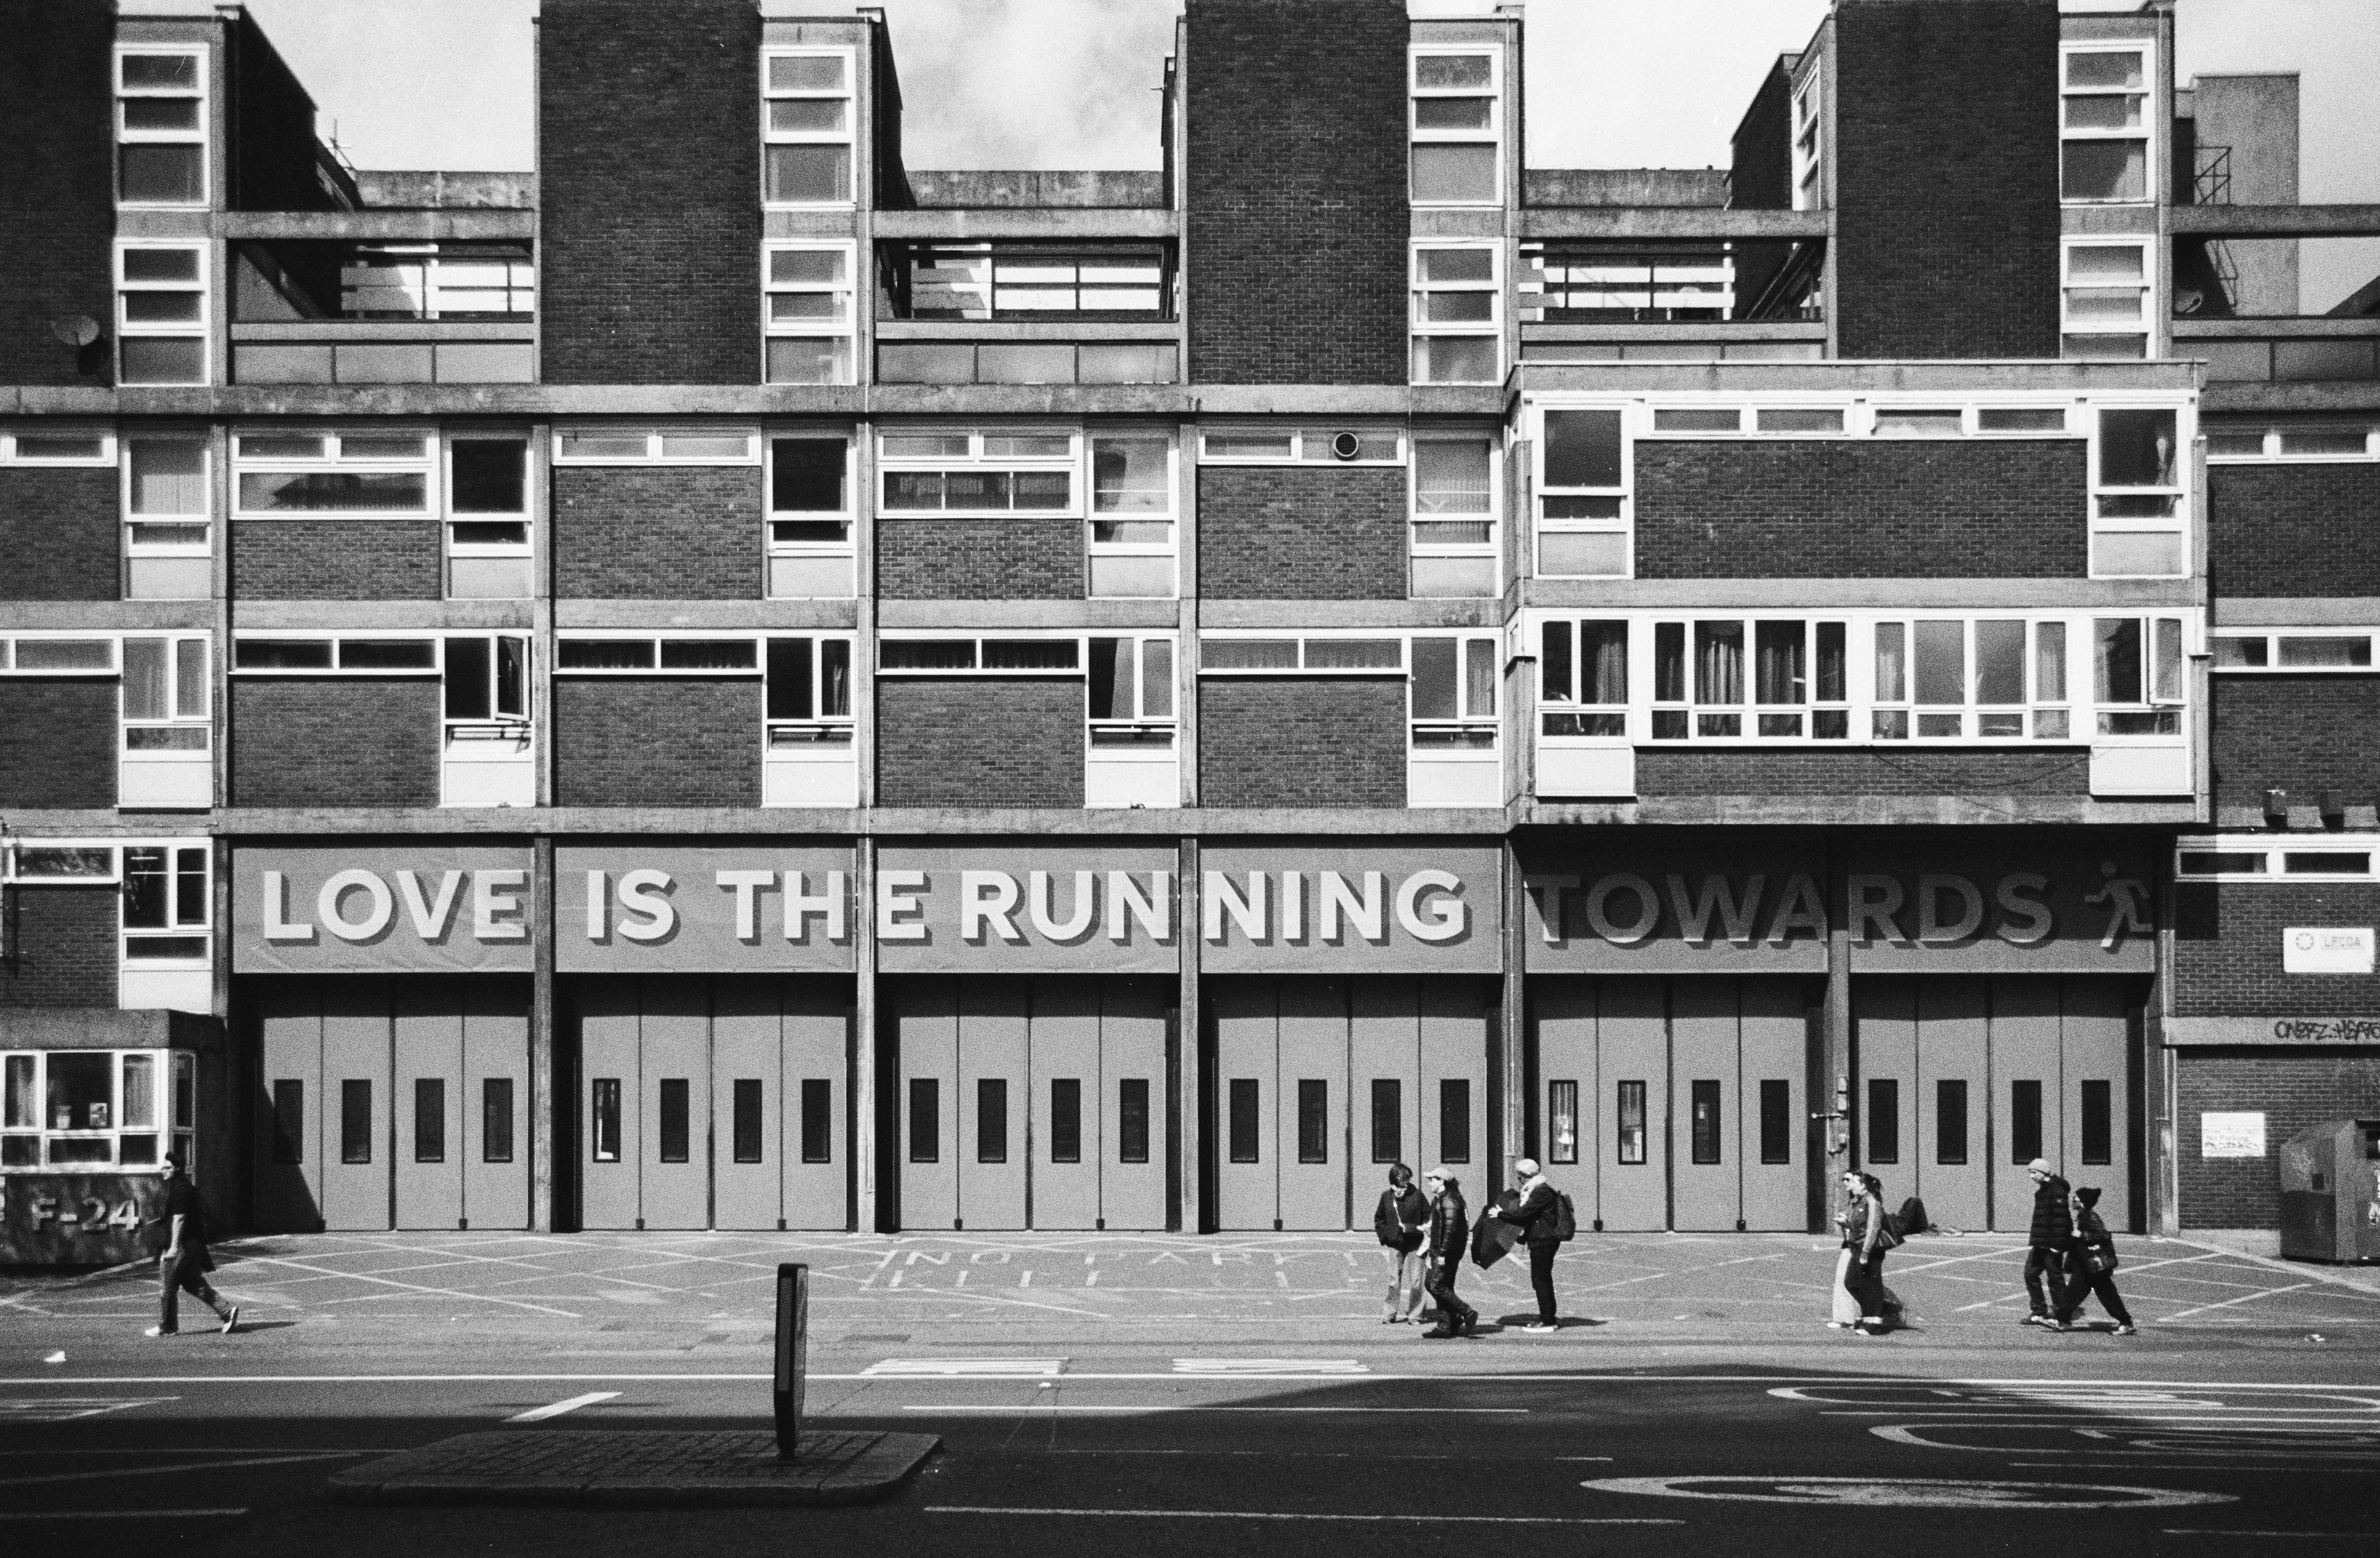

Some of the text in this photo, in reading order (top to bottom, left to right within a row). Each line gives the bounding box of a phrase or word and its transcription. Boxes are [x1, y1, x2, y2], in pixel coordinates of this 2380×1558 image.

[263, 869, 2055, 947] LOVE IS THE RUNNING TOWARDS
[31, 1196, 140, 1232] F-24
